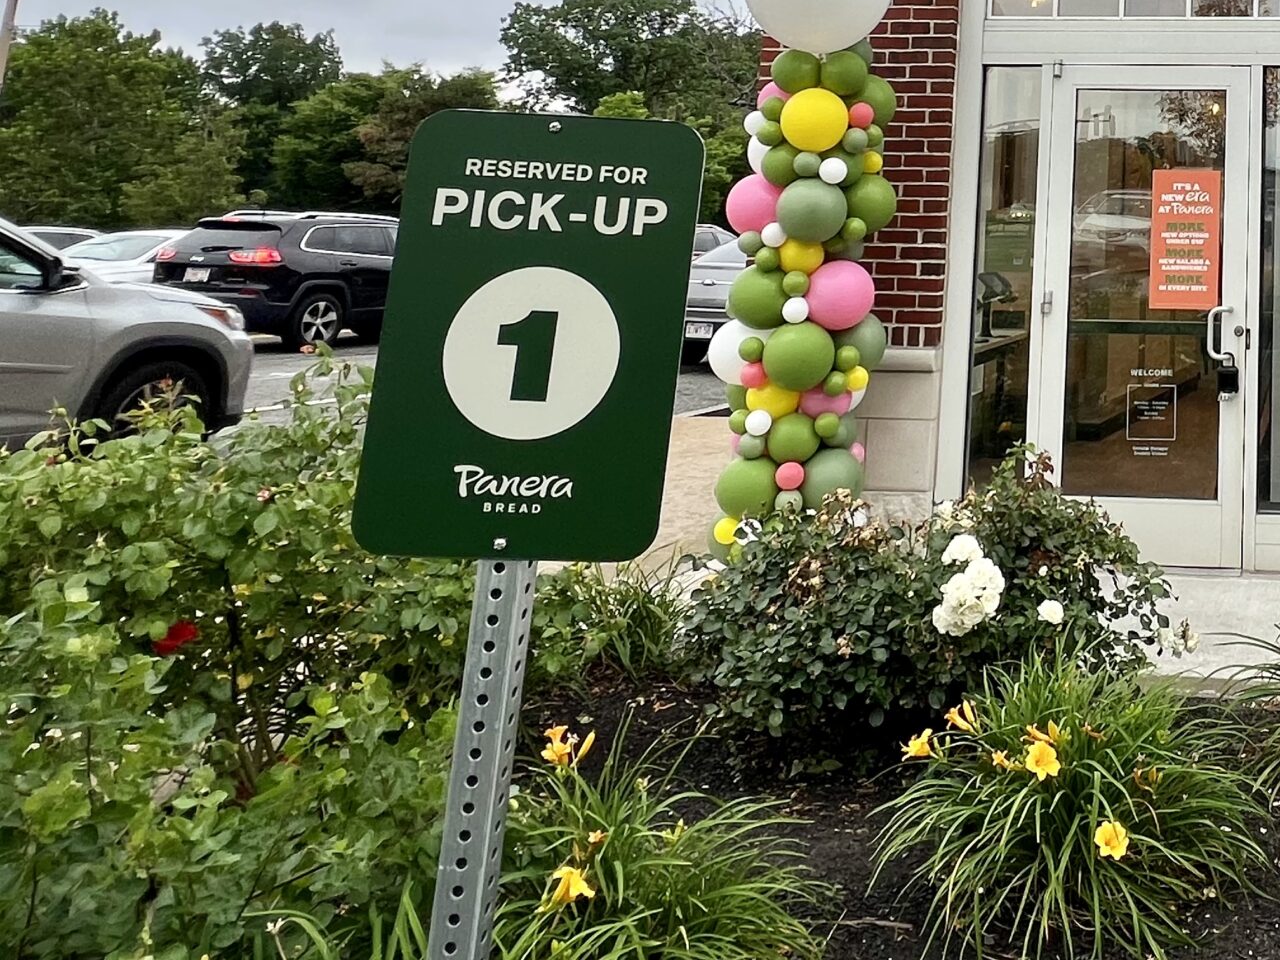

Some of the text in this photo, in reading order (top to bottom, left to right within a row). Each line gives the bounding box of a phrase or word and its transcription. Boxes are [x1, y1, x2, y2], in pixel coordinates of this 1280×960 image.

[465, 158, 648, 185] RESERVED FOR
[1173, 183, 1200, 191] IT'S A
[1161, 191, 1210, 202] NEW era
[431, 187, 668, 236] PICK-UP
[1158, 202, 1214, 215] AT Panera
[1166, 222, 1205, 232] MORE
[1165, 248, 1204, 257] MORE
[1165, 275, 1203, 284] MORE
[497, 310, 559, 403] 1
[453, 464, 574, 499] Panera
[482, 502, 542, 515] BREAD
